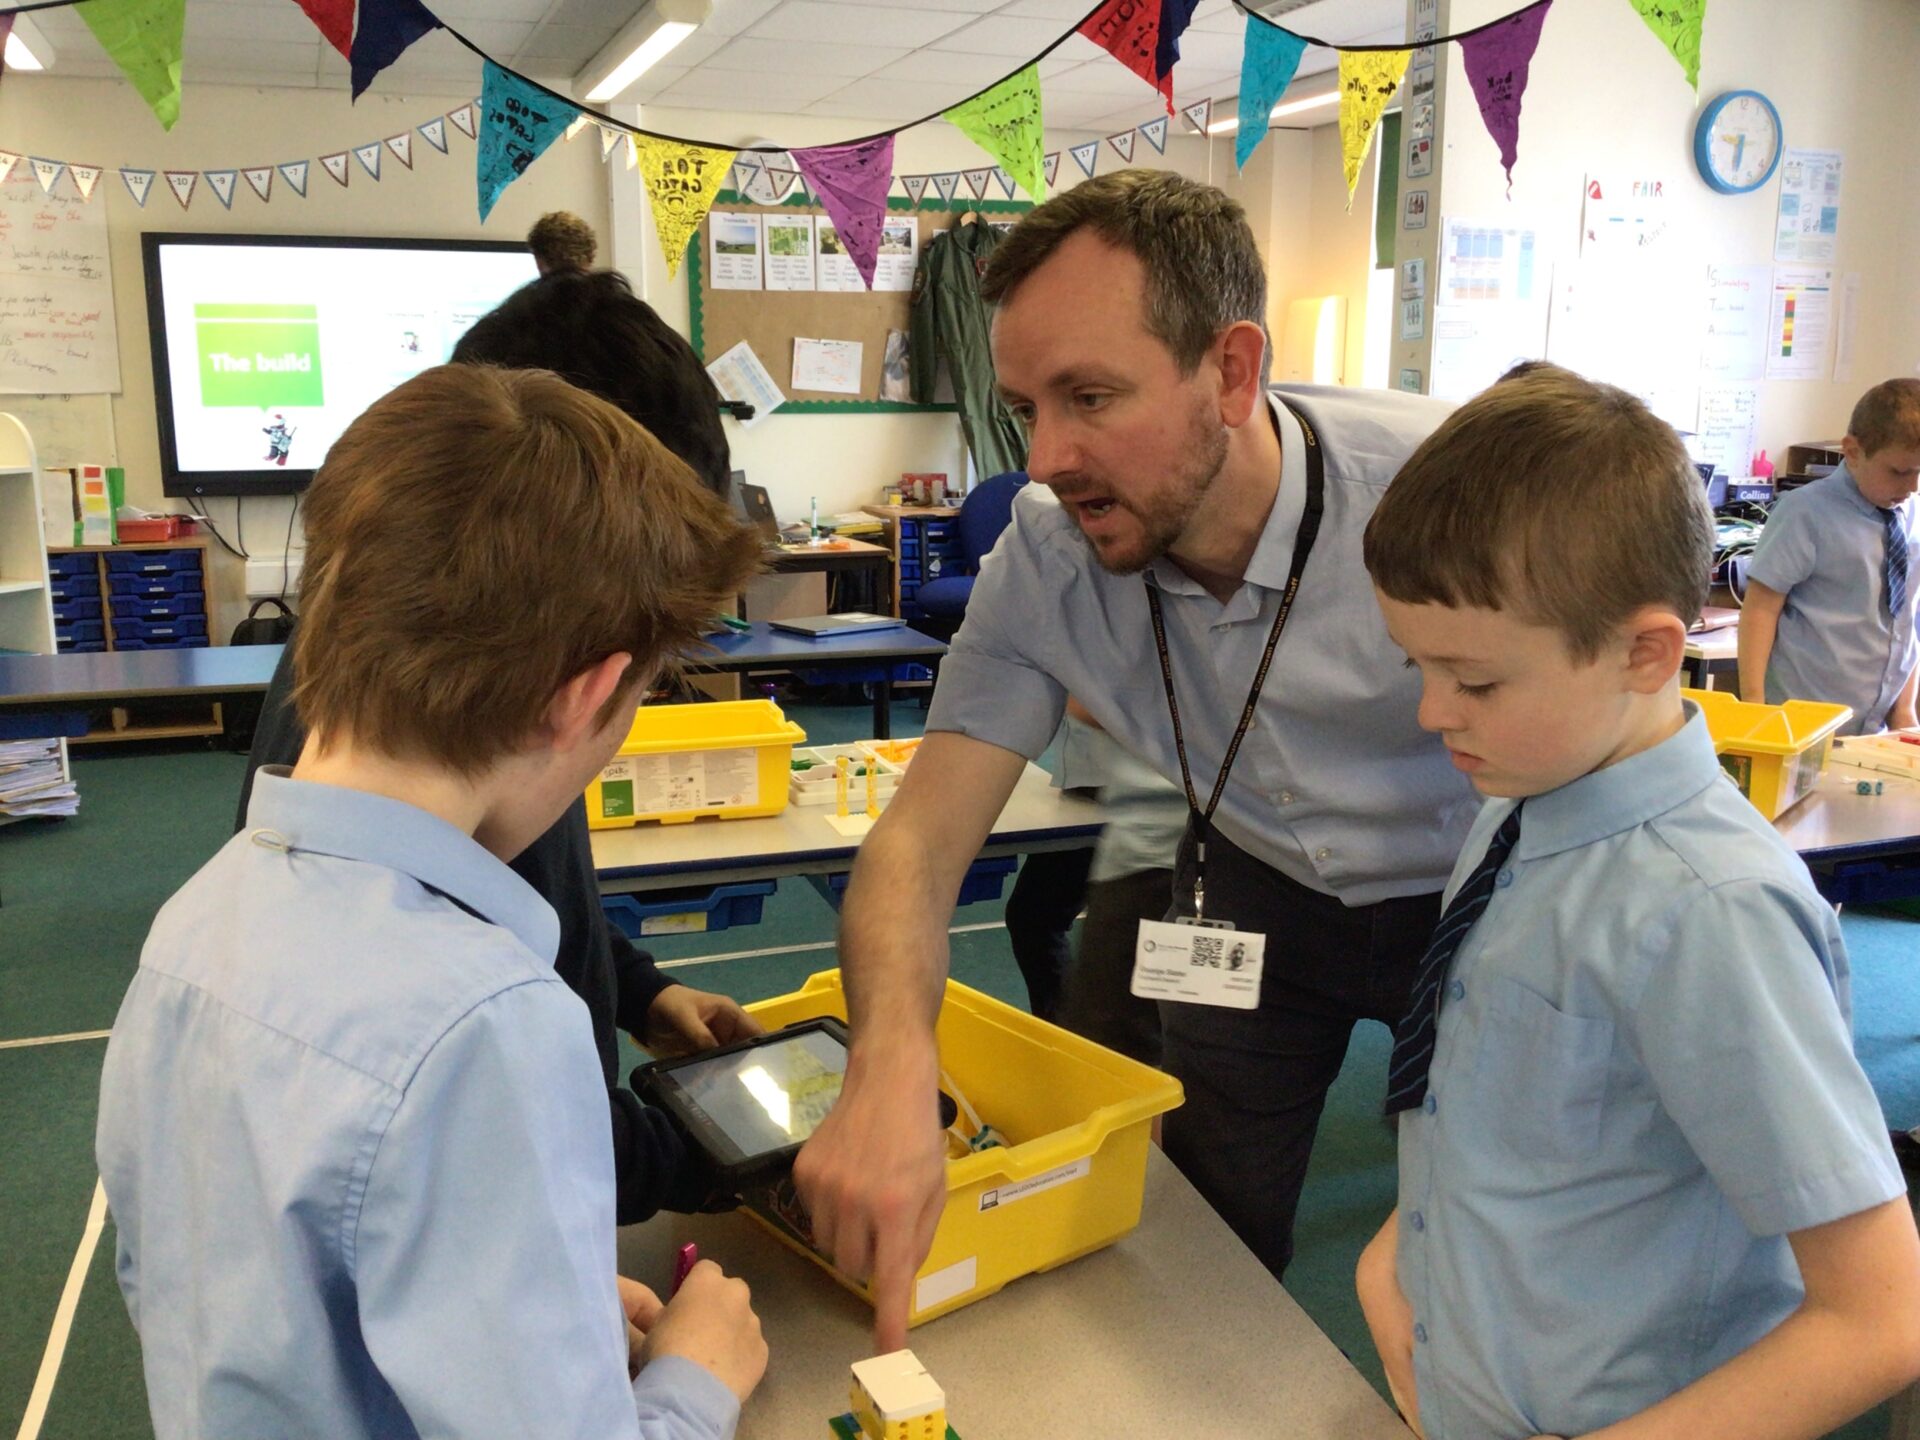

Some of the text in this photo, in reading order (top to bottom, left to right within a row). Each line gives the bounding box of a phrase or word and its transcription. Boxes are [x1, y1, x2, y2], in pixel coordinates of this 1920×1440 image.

[1740, 98, 1749, 110] 12
[1193, 108, 1204, 117] 20
[1150, 126, 1160, 135] 19
[1118, 138, 1128, 146] 18
[1080, 149, 1090, 157] 17
[330, 160, 340, 168] -6
[37, 164, 53, 174] -13
[289, 168, 298, 176] -7
[75, 170, 91, 179] -12
[973, 174, 982, 182] 14
[129, 176, 144, 185] -11
[173, 177, 188, 186] -10
[215, 177, 226, 185] -9
[911, 179, 921, 187] 12
[941, 177, 951, 186] 13
[1632, 181, 1663, 197] FAIR
[208, 352, 311, 372] The build
[1740, 490, 1770, 500] Collins
[1285, 576, 1298, 603] Staff
